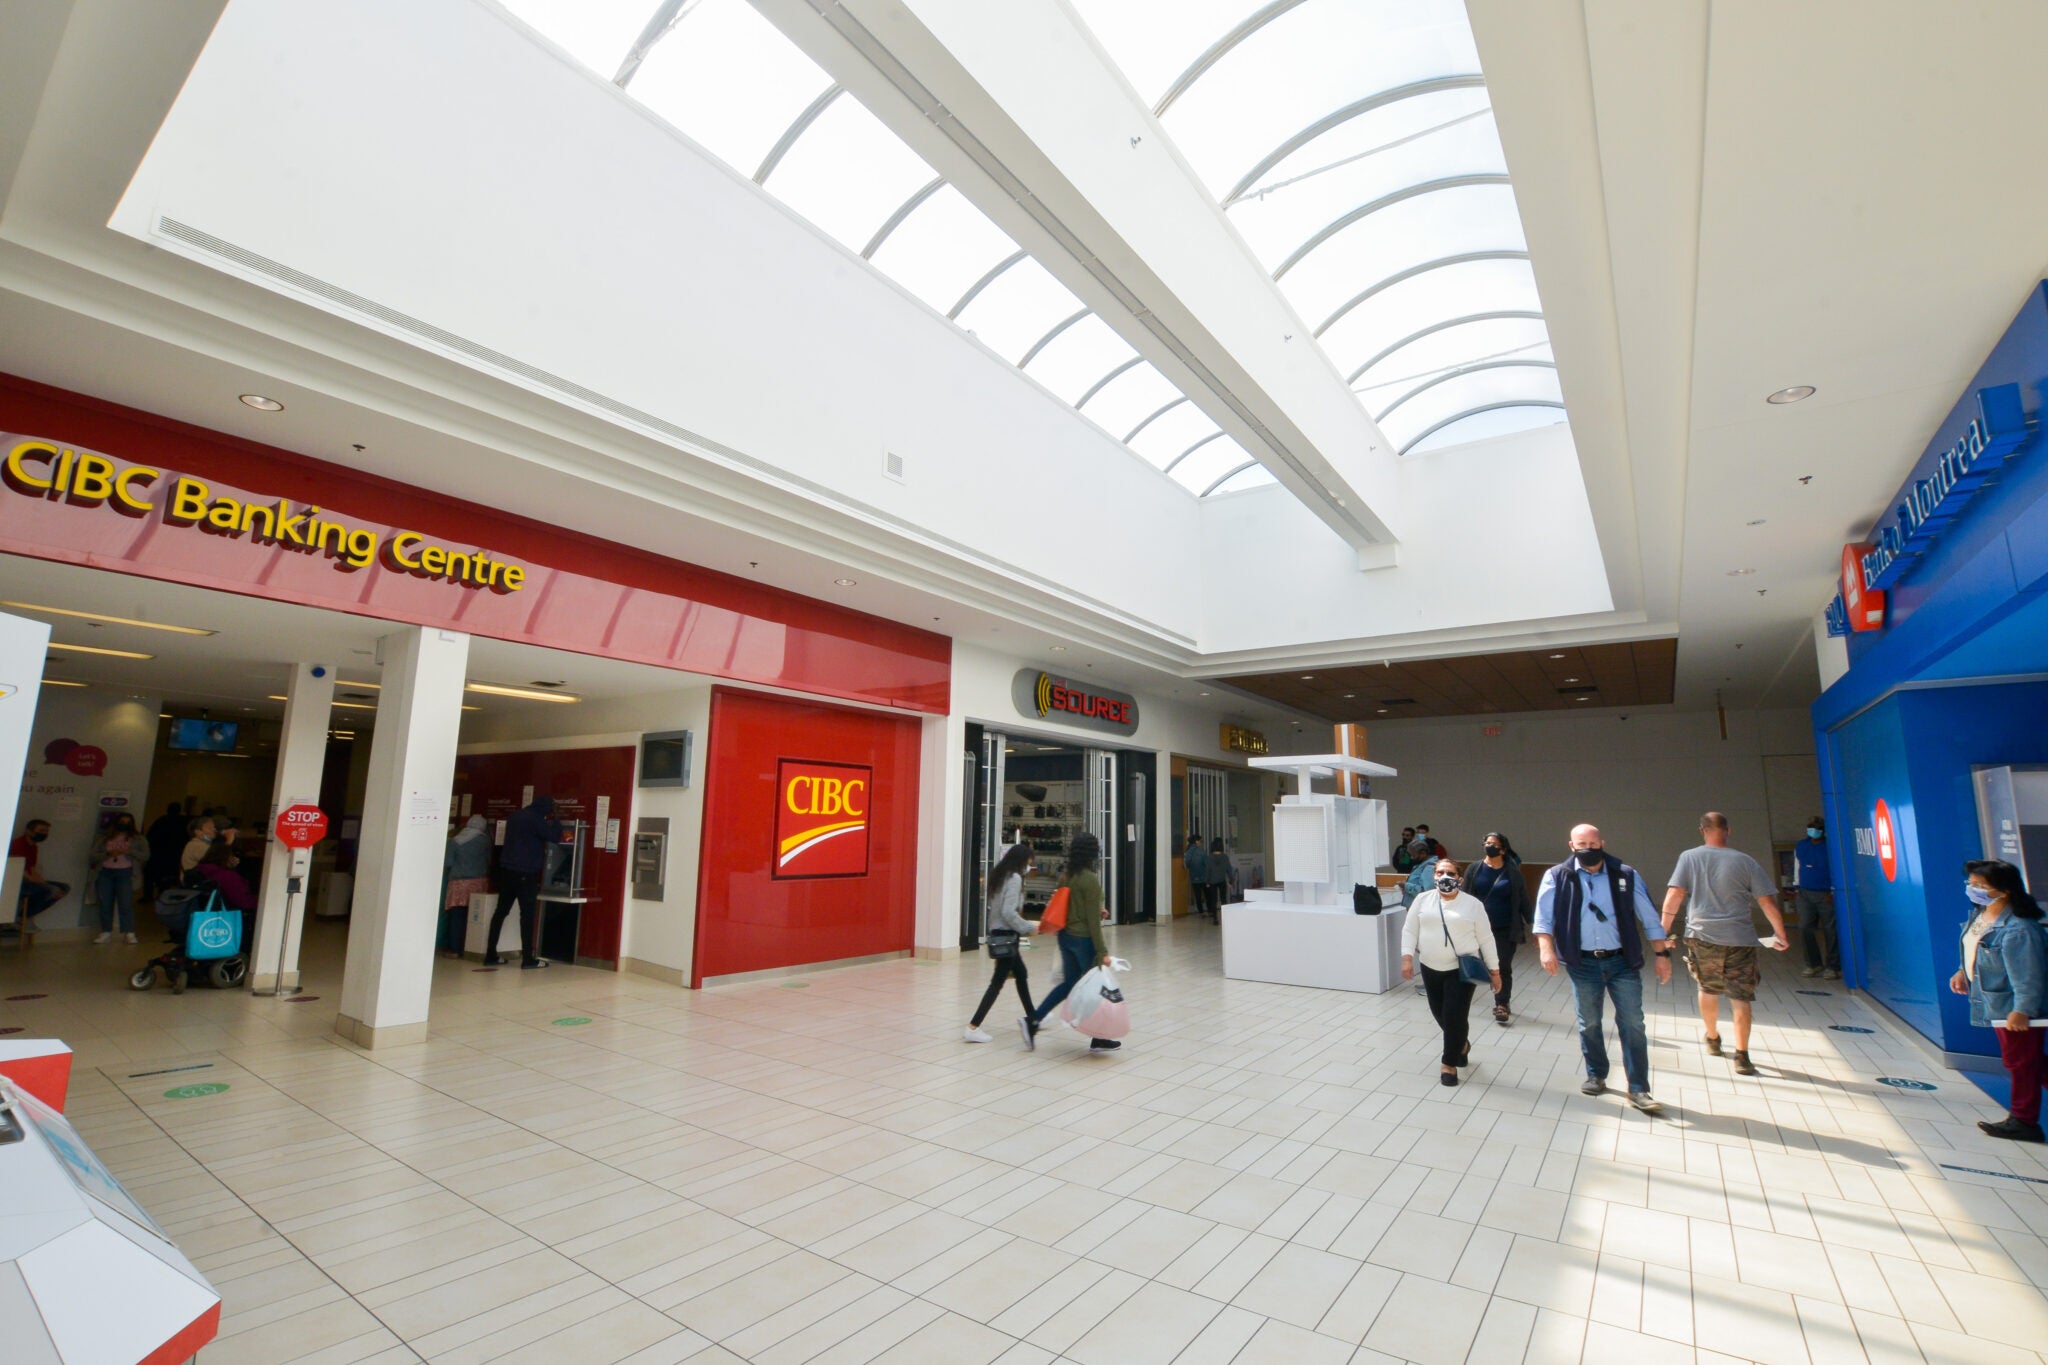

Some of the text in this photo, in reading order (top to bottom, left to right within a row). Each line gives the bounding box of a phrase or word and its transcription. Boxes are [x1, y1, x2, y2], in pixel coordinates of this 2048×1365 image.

[1904, 392, 1991, 537] Montreal
[4, 441, 525, 594] CIBC Banking Centre
[1053, 686, 1132, 724] SOURCE
[36, 784, 75, 796] again
[786, 775, 865, 816] CIBC
[287, 811, 320, 822] STOP
[1854, 827, 1876, 857] BMO
